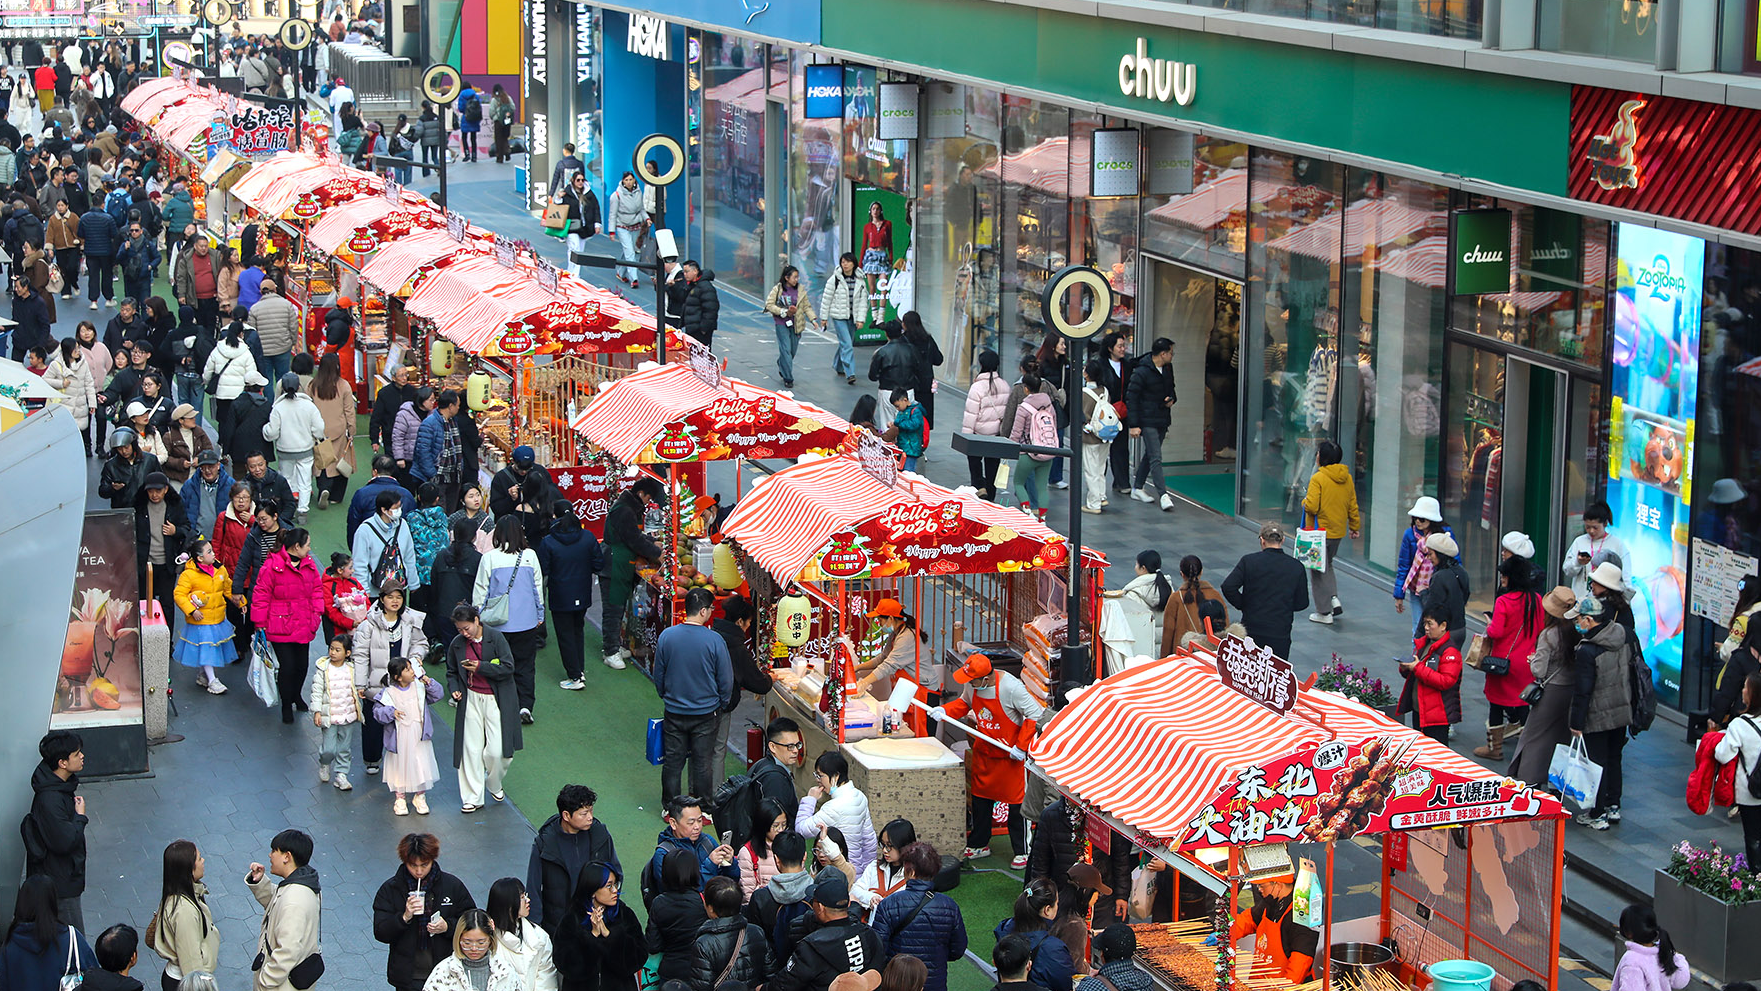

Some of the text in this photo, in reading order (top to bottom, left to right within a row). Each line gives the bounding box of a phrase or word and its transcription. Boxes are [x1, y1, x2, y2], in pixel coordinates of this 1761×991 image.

[627, 13, 667, 61] HOKA
[532, 58, 546, 86] FLY
[1119, 37, 1197, 106] chuu
[807, 86, 842, 98] HOKA
[232, 105, 295, 132] 哈尔滨
[882, 109, 914, 118] crocs
[236, 128, 288, 151] 烤香肠
[533, 113, 547, 155] HOKA
[1588, 138, 1619, 160] Hot
[1097, 161, 1133, 170] crocs
[1590, 160, 1633, 186] Toys
[325, 179, 354, 192] Hello
[330, 187, 357, 199] 2026
[533, 182, 548, 208] FLY
[383, 212, 412, 225] Hello
[389, 220, 418, 233] 2026
[1463, 244, 1504, 263] chuu
[541, 303, 579, 319] Hello
[548, 314, 584, 328] 2026
[705, 398, 749, 417] Hello
[715, 411, 756, 430] 2026
[726, 431, 802, 446] Happy New Year
[880, 506, 932, 528] Hello
[1636, 501, 1661, 531] 狸宝
[890, 519, 939, 541] 2026
[83, 556, 106, 566] TEA
[904, 543, 993, 560] Happy New Year
[1317, 744, 1345, 767] 爆汁
[1231, 762, 1318, 801] 东北
[1399, 771, 1425, 787] 超满足
[1427, 780, 1501, 808] 人气爆款
[1400, 806, 1506, 826] 金黄酥脆 鲜嫩多汁
